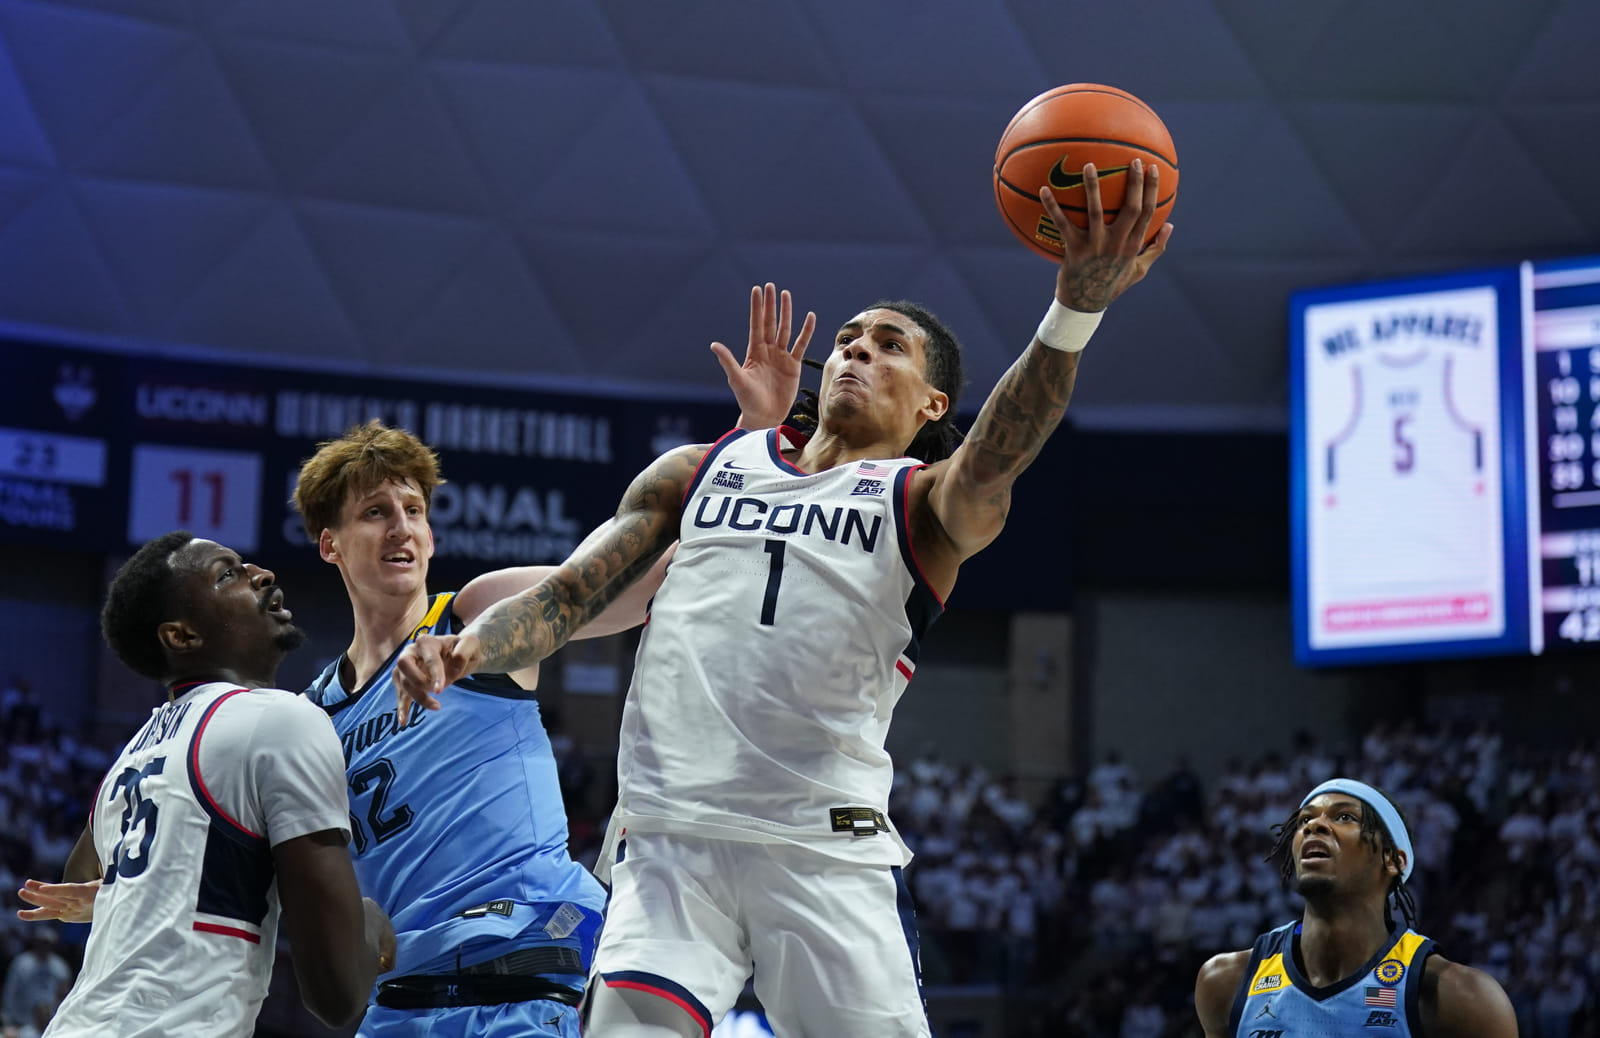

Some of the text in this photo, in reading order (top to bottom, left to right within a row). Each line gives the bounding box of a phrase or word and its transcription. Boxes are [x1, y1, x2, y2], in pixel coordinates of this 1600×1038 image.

[135, 386, 267, 426] UCONN
[425, 401, 612, 464] BASKETBALL
[1393, 411, 1415, 474] 5
[711, 477, 744, 490] CHANGE
[716, 470, 744, 482] BE THE
[852, 486, 886, 494] EAST
[858, 479, 882, 488] BIG
[169, 469, 227, 529] 11
[694, 495, 882, 553] UCONN
[760, 539, 786, 625] 1
[349, 757, 415, 856] 2
[1366, 1018, 1398, 1026] EAST
[1369, 1010, 1392, 1018] BIG
